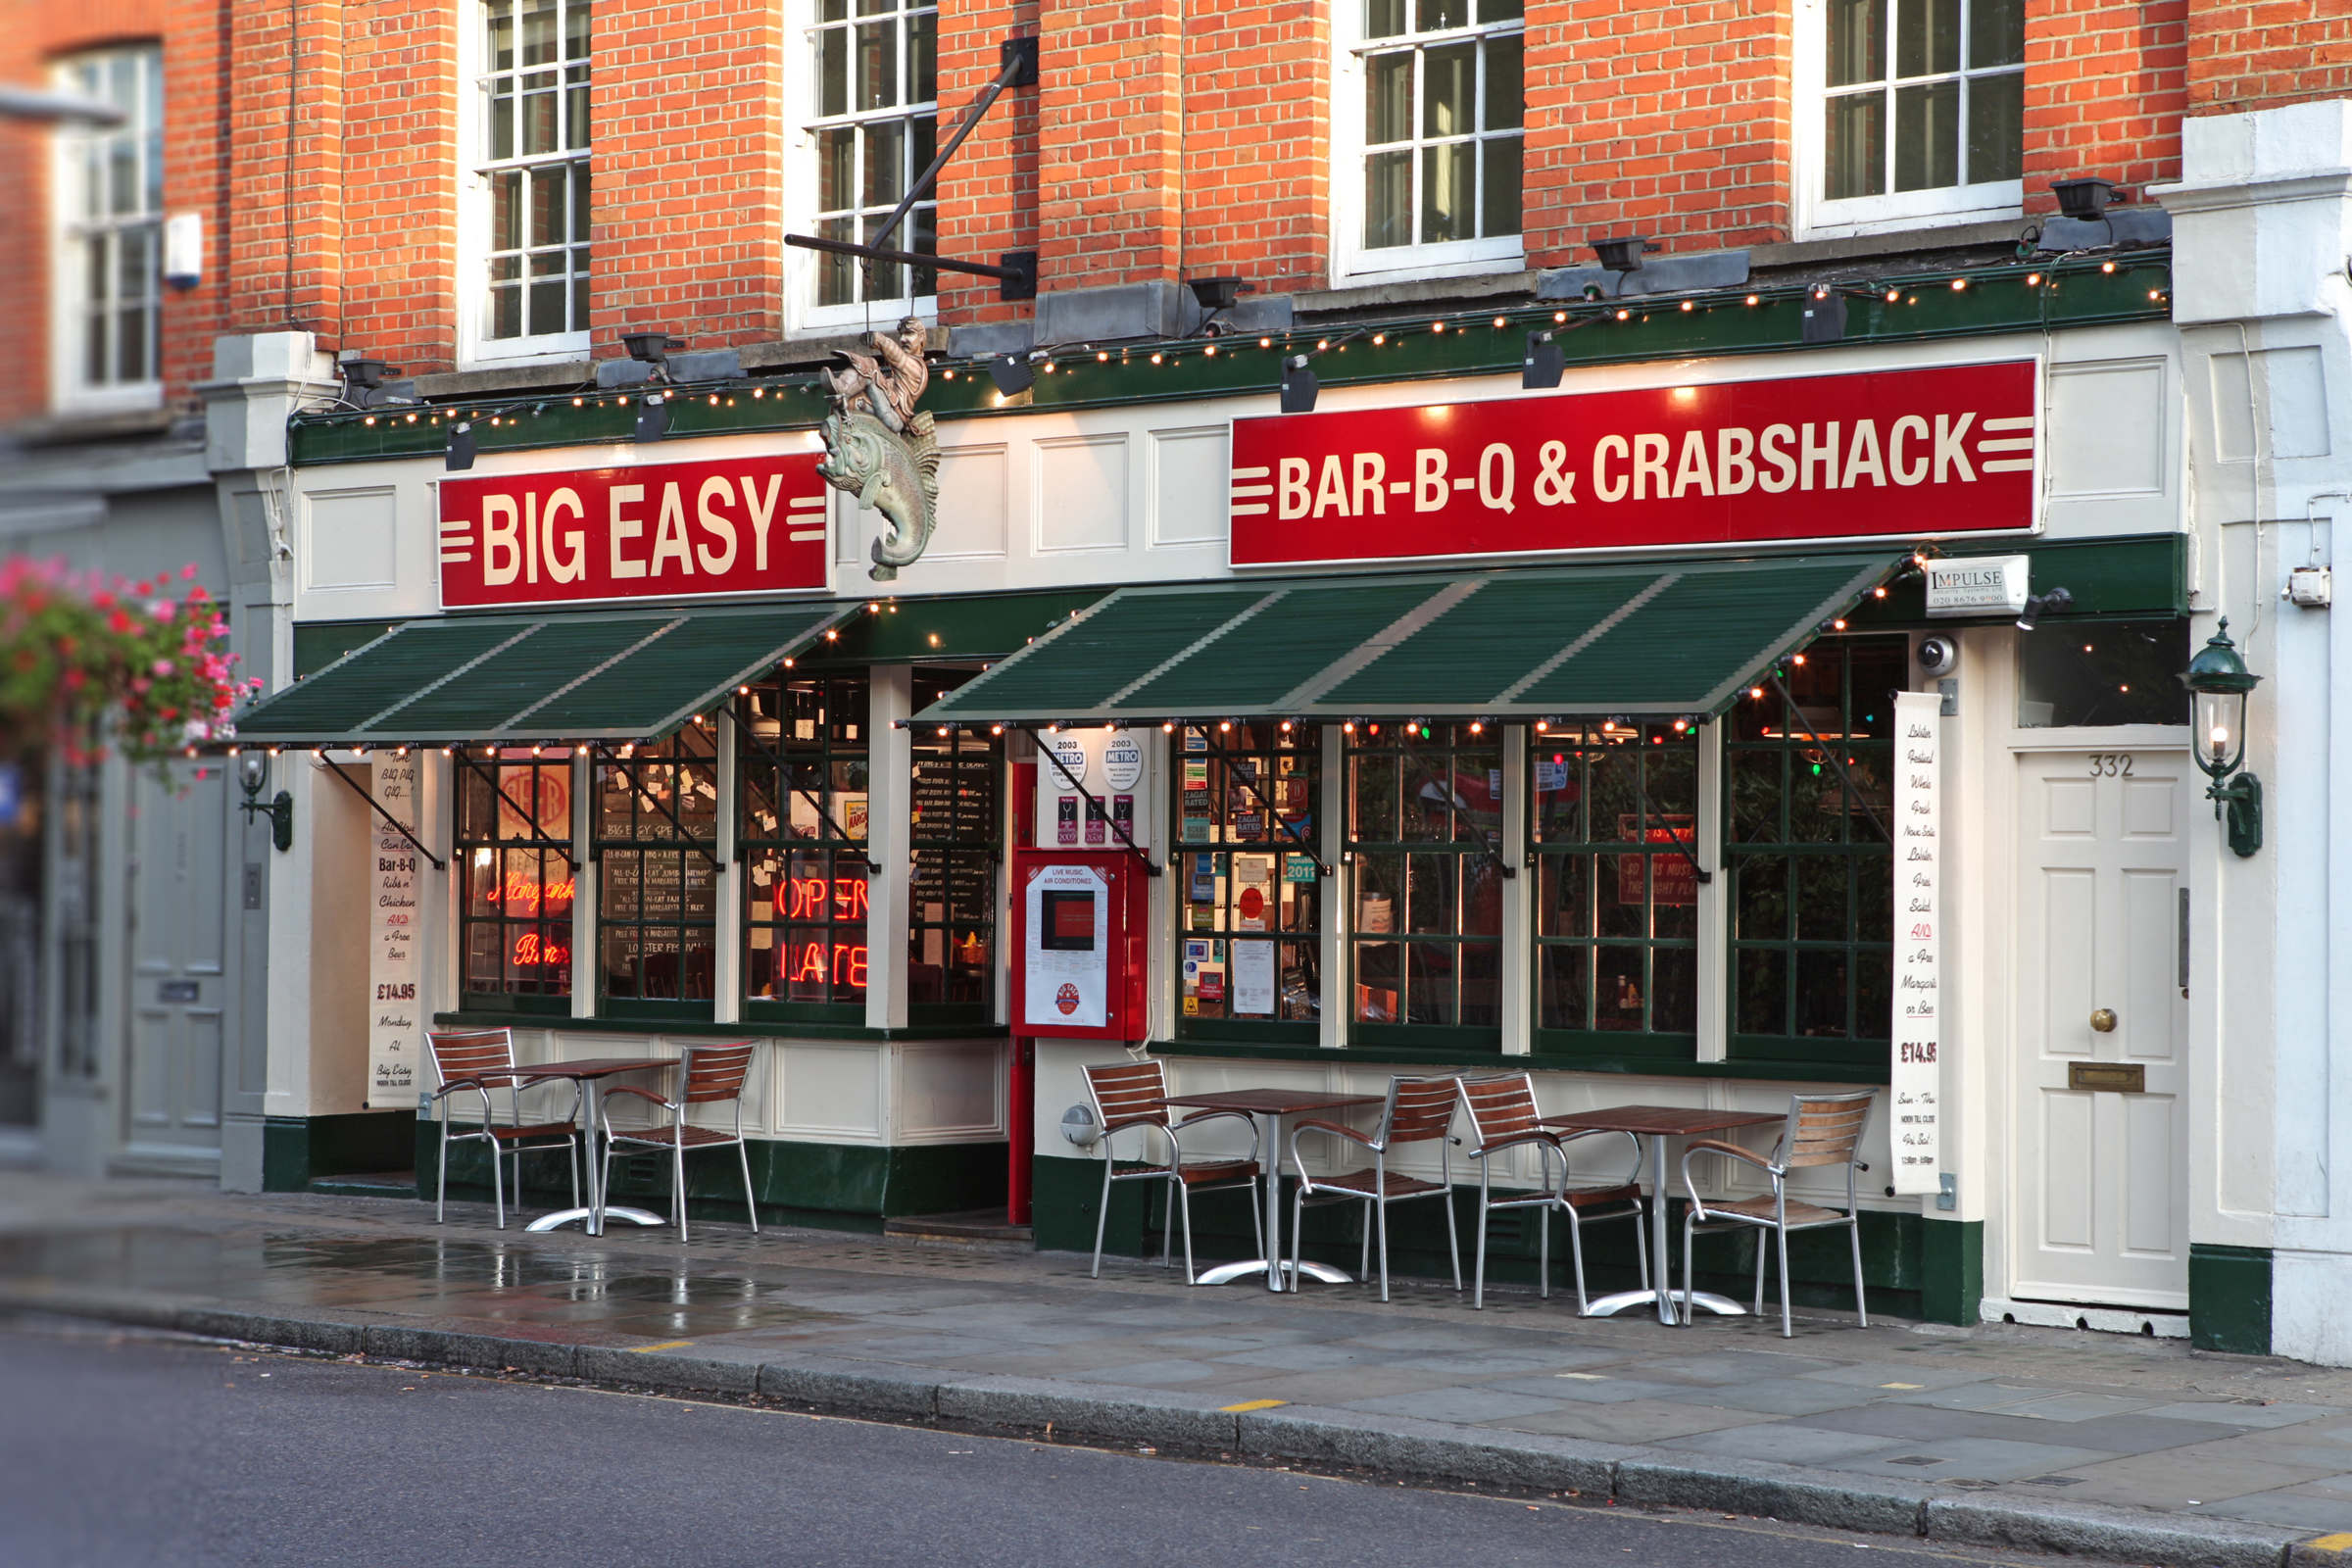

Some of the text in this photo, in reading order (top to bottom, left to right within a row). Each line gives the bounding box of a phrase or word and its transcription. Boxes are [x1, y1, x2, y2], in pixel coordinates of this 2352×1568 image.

[1278, 412, 1978, 520] BAR-B-Q & CRABSHACK
[483, 474, 783, 585] BIG EASY
[1931, 571, 2002, 590] IMPULSE
[1107, 751, 1138, 762] METRO
[2088, 754, 2134, 777] 332
[381, 768, 415, 781] BIG PIG
[1911, 800, 1931, 814] Fresh
[608, 824, 623, 835] BIG
[626, 825, 651, 835] ESY
[381, 838, 399, 850] Can
[1058, 833, 1076, 842] 2009
[379, 858, 416, 872] Bar-B-Q
[1288, 865, 1315, 878] 2011
[1627, 862, 1690, 876] SO MUST
[382, 876, 402, 889] Ribs
[1628, 881, 1695, 895] THE IGHT PLA
[379, 895, 416, 907] Chicken
[387, 914, 409, 924] AND
[392, 930, 411, 942] Free
[1911, 923, 1933, 938] AND
[388, 946, 406, 958] Beer
[1908, 949, 1934, 963] a Free
[781, 942, 868, 986] LATE
[377, 983, 416, 1001] £14.95
[1067, 984, 1078, 996] EASY
[1906, 1004, 1916, 1014] or
[378, 1015, 412, 1029] Monday
[389, 1041, 401, 1052] At
[1901, 1042, 1936, 1063] £14.95
[376, 1064, 412, 1078] Big Easy
[1898, 1092, 1914, 1104] Sun
